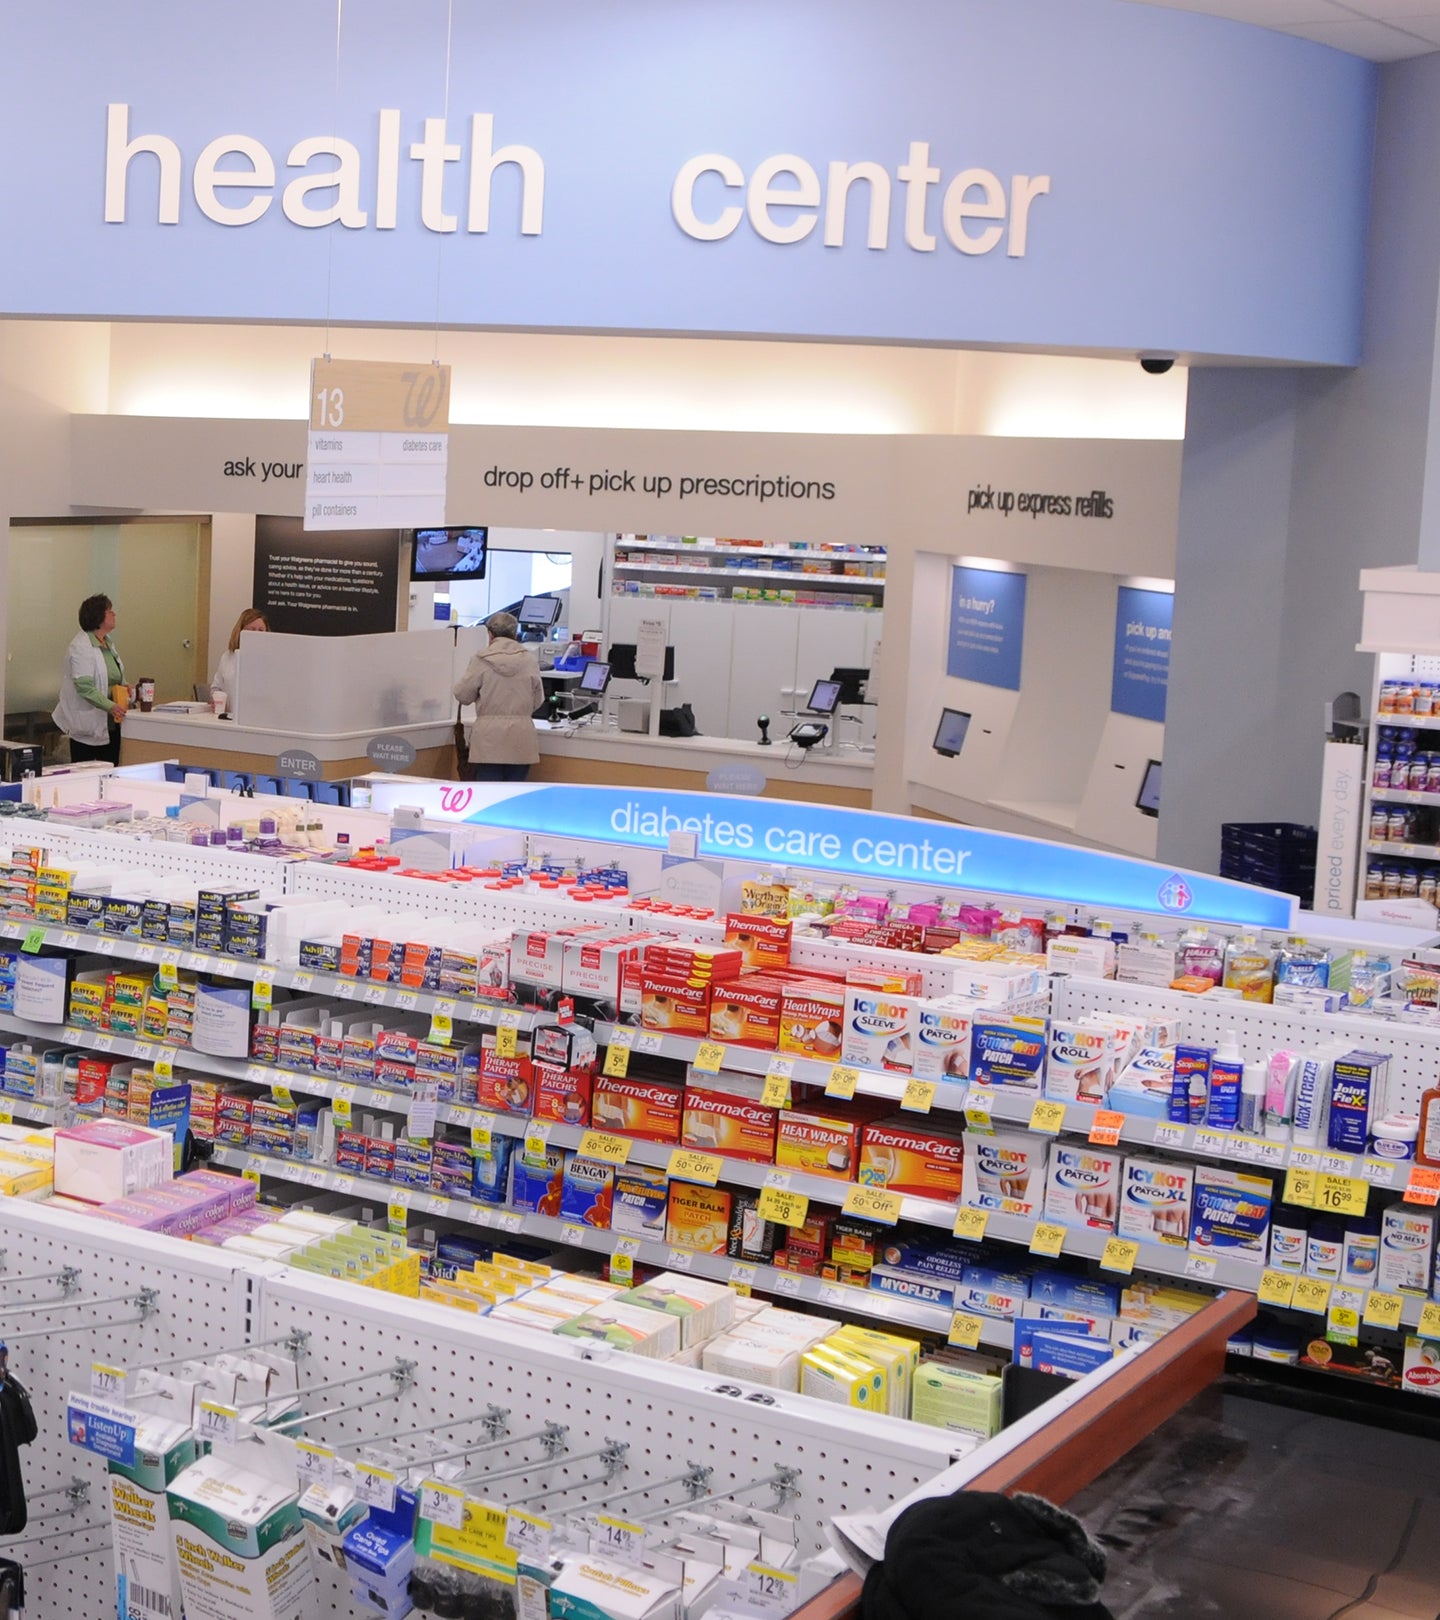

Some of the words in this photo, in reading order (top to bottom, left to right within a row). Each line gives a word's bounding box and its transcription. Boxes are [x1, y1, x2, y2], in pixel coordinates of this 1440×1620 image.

[105, 103, 545, 236] health
[672, 141, 1050, 257] center
[317, 388, 344, 428] 13
[315, 438, 343, 451] vitamins
[402, 439, 427, 451] diabetes
[428, 441, 442, 451] care
[224, 457, 256, 476] ask
[261, 462, 303, 482] your
[313, 472, 331, 484] heart
[331, 472, 352, 484] health
[484, 466, 533, 493] drop
[589, 469, 635, 495] pick
[643, 475, 672, 498] up
[680, 474, 835, 502] prescriptions
[968, 484, 995, 514] pick
[998, 491, 1014, 517] up
[1018, 493, 1072, 519] express
[1075, 490, 1113, 518] refills
[312, 504, 323, 518] pill
[323, 504, 357, 516] containers
[972, 599, 995, 615] hurry?
[1126, 621, 1145, 637] pick
[1146, 625, 1157, 638] up
[377, 743, 404, 752] PLEASE
[281, 758, 316, 771] ENTER
[372, 752, 389, 760] WAIT
[391, 753, 409, 761] HERE
[1332, 806, 1350, 850] every
[611, 802, 754, 848] diabetes
[764, 827, 842, 860] care
[852, 836, 971, 874] center
[1327, 855, 1342, 910] priced
[728, 918, 787, 936] ThermaCare
[1186, 947, 1215, 958] HALLS
[516, 958, 554, 972] PRECISE
[569, 969, 609, 982] PRECISE
[643, 979, 704, 999] ThermaCare
[714, 987, 778, 1007] ThermaCare
[860, 1016, 896, 1030] SLEEVE
[926, 1028, 957, 1041] PATCH
[982, 1049, 1013, 1064] PATCH
[1060, 1046, 1090, 1058] ROLL
[484, 1055, 520, 1069] THERAPY
[596, 1076, 679, 1103] ThermaCare
[1333, 1082, 1366, 1097] Joint
[687, 1094, 773, 1123] ThermaCare
[781, 1124, 808, 1137] HEAT
[810, 1130, 849, 1145] WRAPS
[866, 1129, 960, 1157] ThermaCare
[570, 1163, 609, 1180] BENGAY
[1064, 1169, 1099, 1183] PATCH
[1327, 1177, 1351, 1186] SALE!
[1135, 1186, 1165, 1198] PATCH
[1166, 1189, 1187, 1201] XL
[672, 1196, 698, 1210] TIGER
[700, 1202, 725, 1214] BALM
[880, 1275, 941, 1301] MYOFLEX
[112, 1487, 154, 1509] Walker
[113, 1500, 156, 1523] Wheels
[178, 1549, 214, 1573] Wheels
[206, 1545, 246, 1573] Walker
